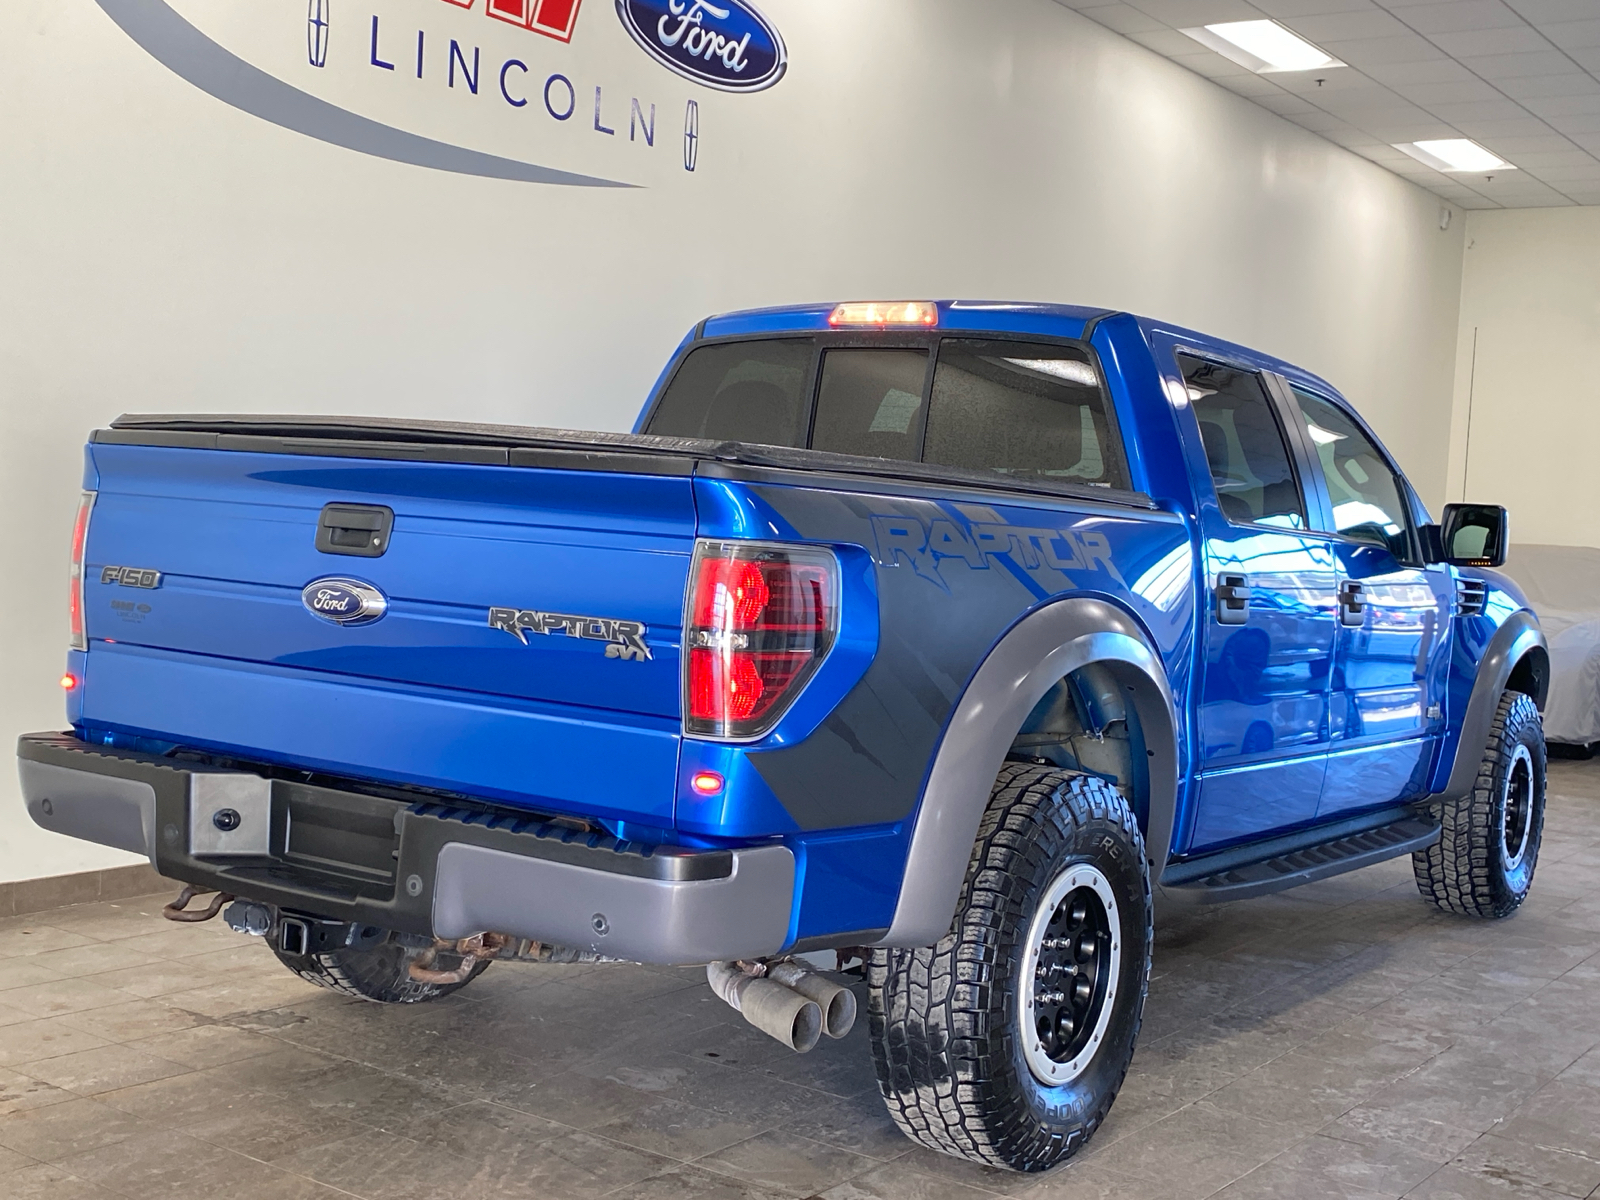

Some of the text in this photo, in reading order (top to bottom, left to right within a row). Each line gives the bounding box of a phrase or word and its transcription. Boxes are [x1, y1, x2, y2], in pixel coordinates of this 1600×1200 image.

[657, 0, 752, 72] Ford
[370, 14, 656, 148] LINCOLN
[101, 565, 159, 589] F-150
[868, 513, 1130, 596] RAPTOR
[313, 588, 350, 612] Ford
[488, 606, 652, 660] RAPTOR
